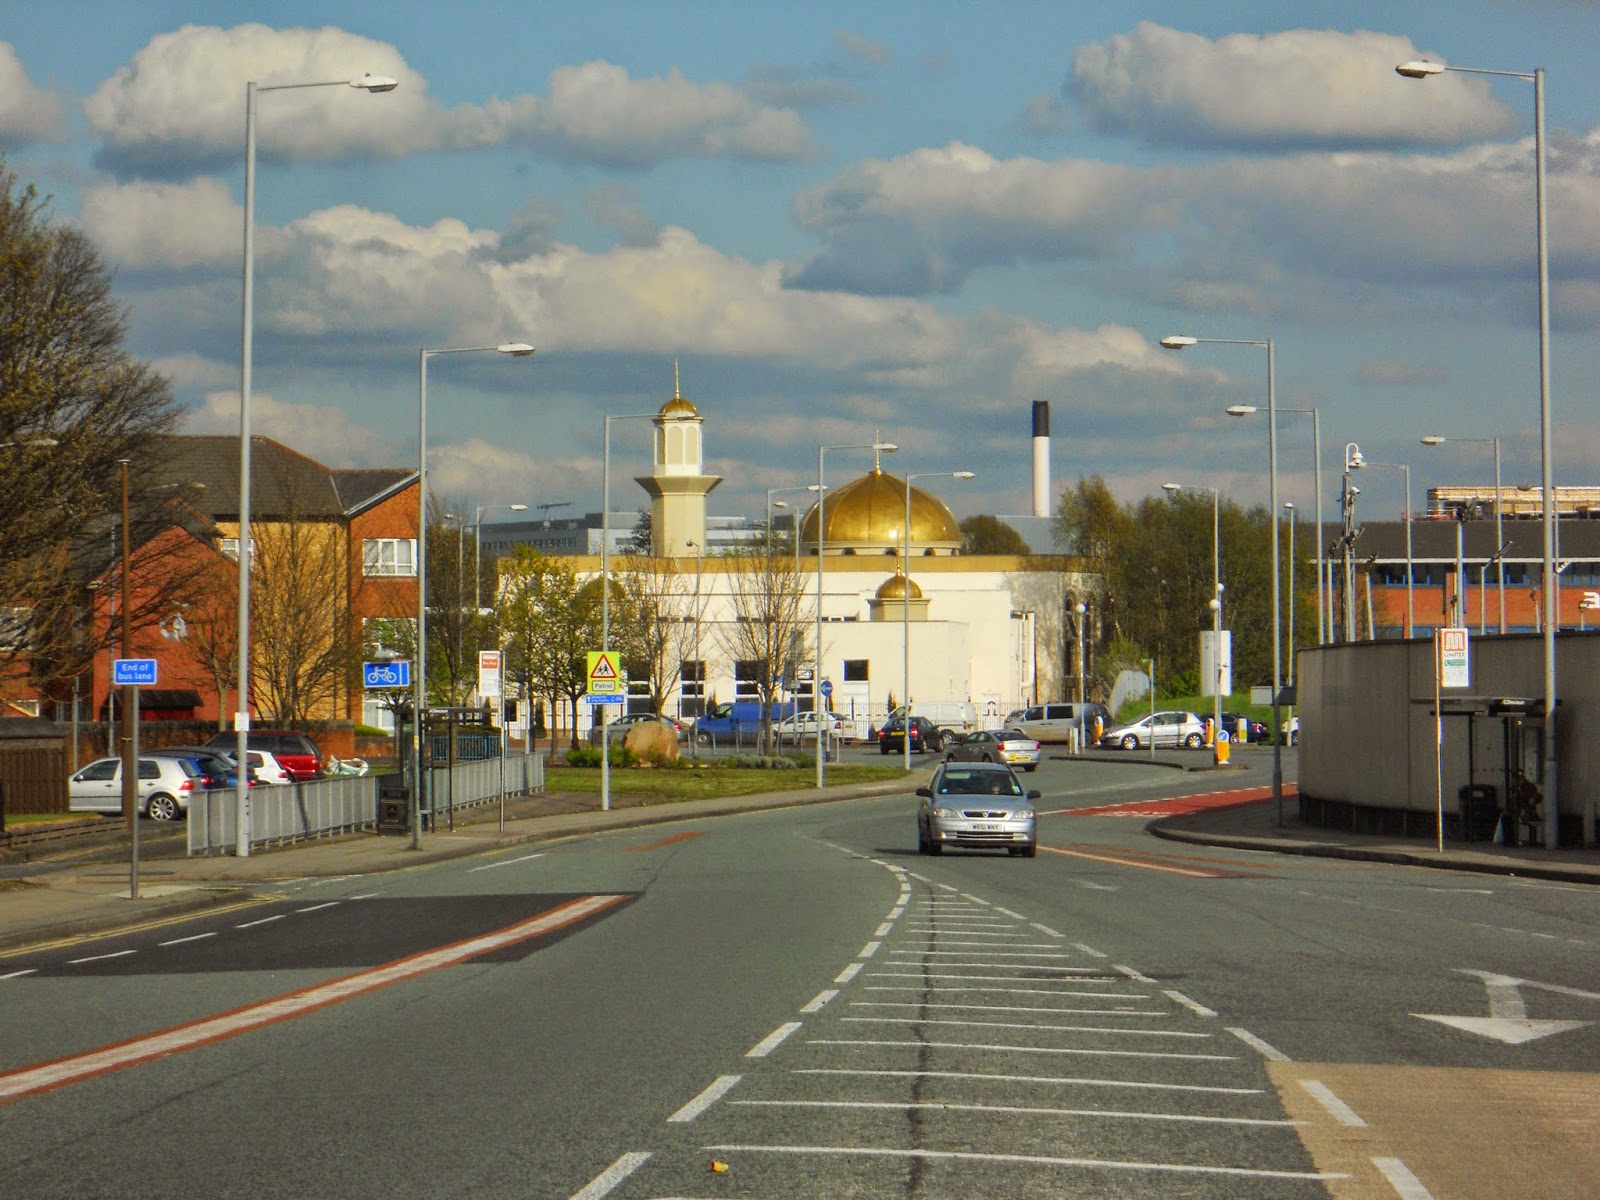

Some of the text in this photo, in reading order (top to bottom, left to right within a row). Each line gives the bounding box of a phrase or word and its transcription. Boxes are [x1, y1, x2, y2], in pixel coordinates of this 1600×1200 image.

[122, 663, 150, 671] End of
[118, 672, 152, 680] bus lane
